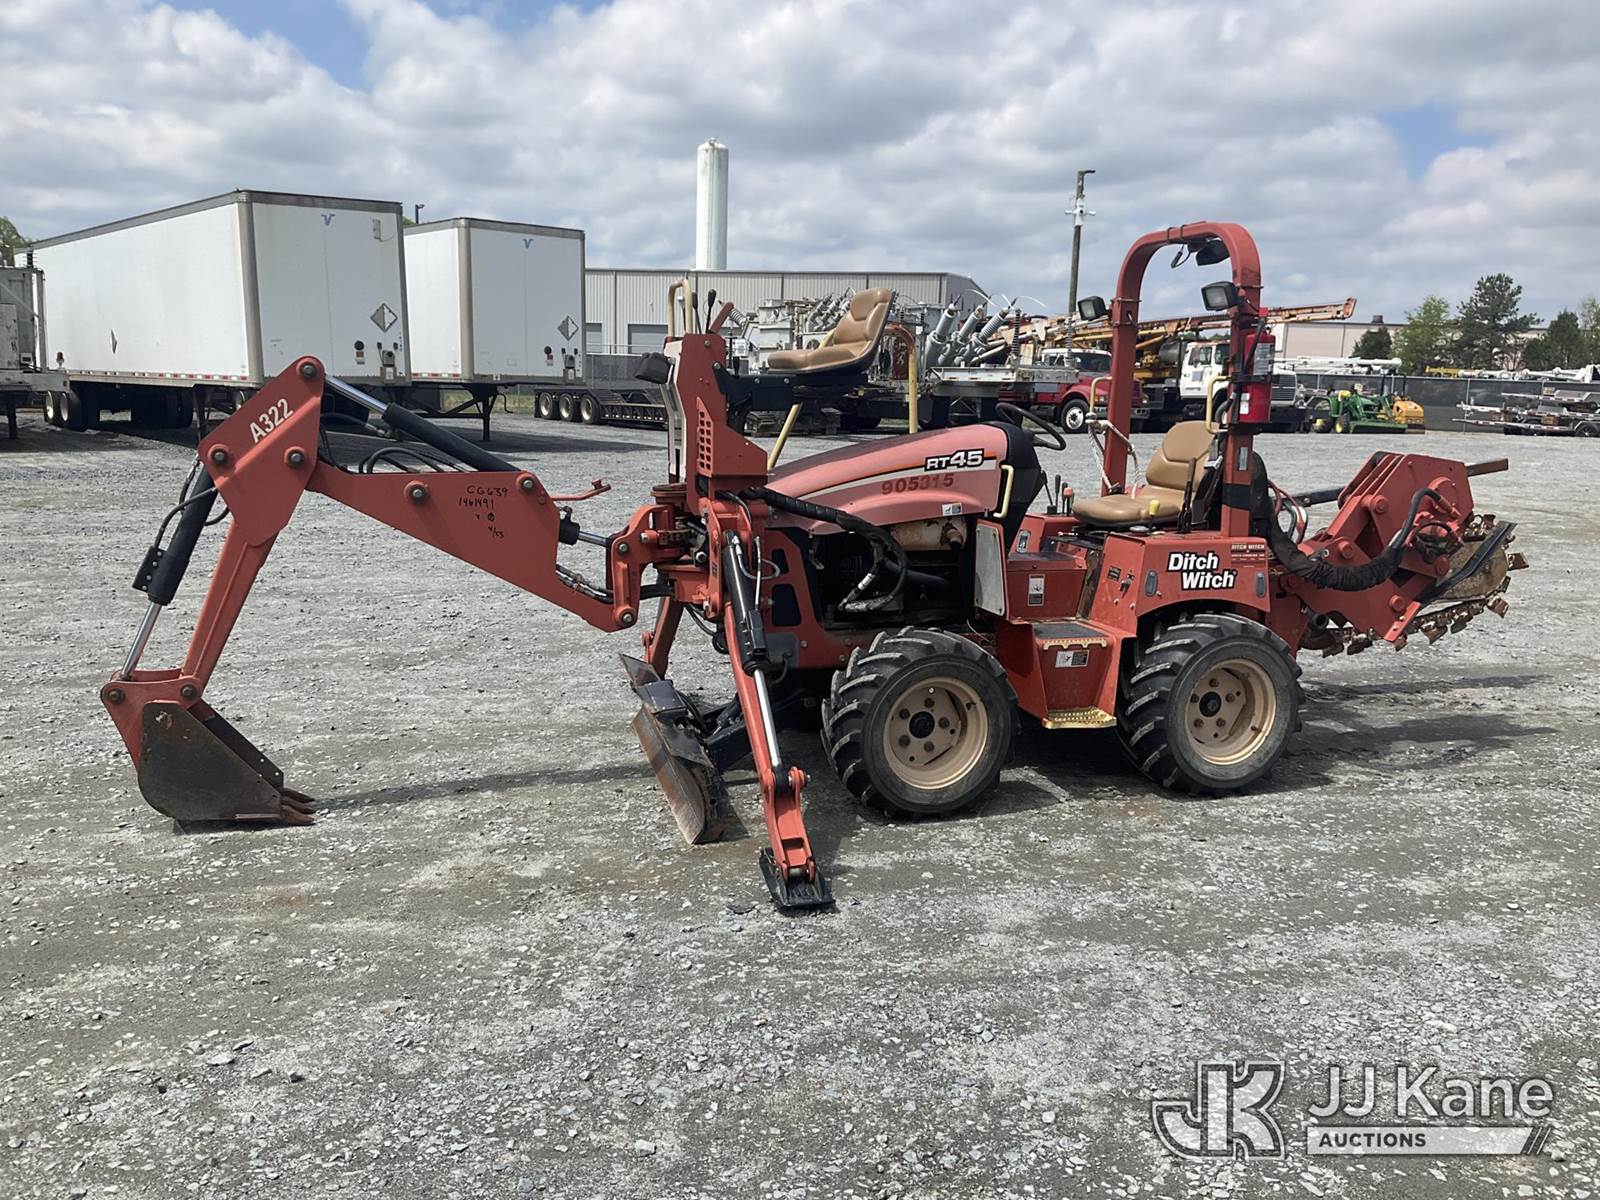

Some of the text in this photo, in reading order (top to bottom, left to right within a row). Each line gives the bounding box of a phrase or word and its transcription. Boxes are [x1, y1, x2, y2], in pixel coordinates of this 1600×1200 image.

[249, 398, 294, 443] A322
[925, 449, 984, 470] RT45
[881, 473, 954, 495] 905315
[1167, 551, 1219, 571] Ditch
[1181, 570, 1236, 590] Witch
